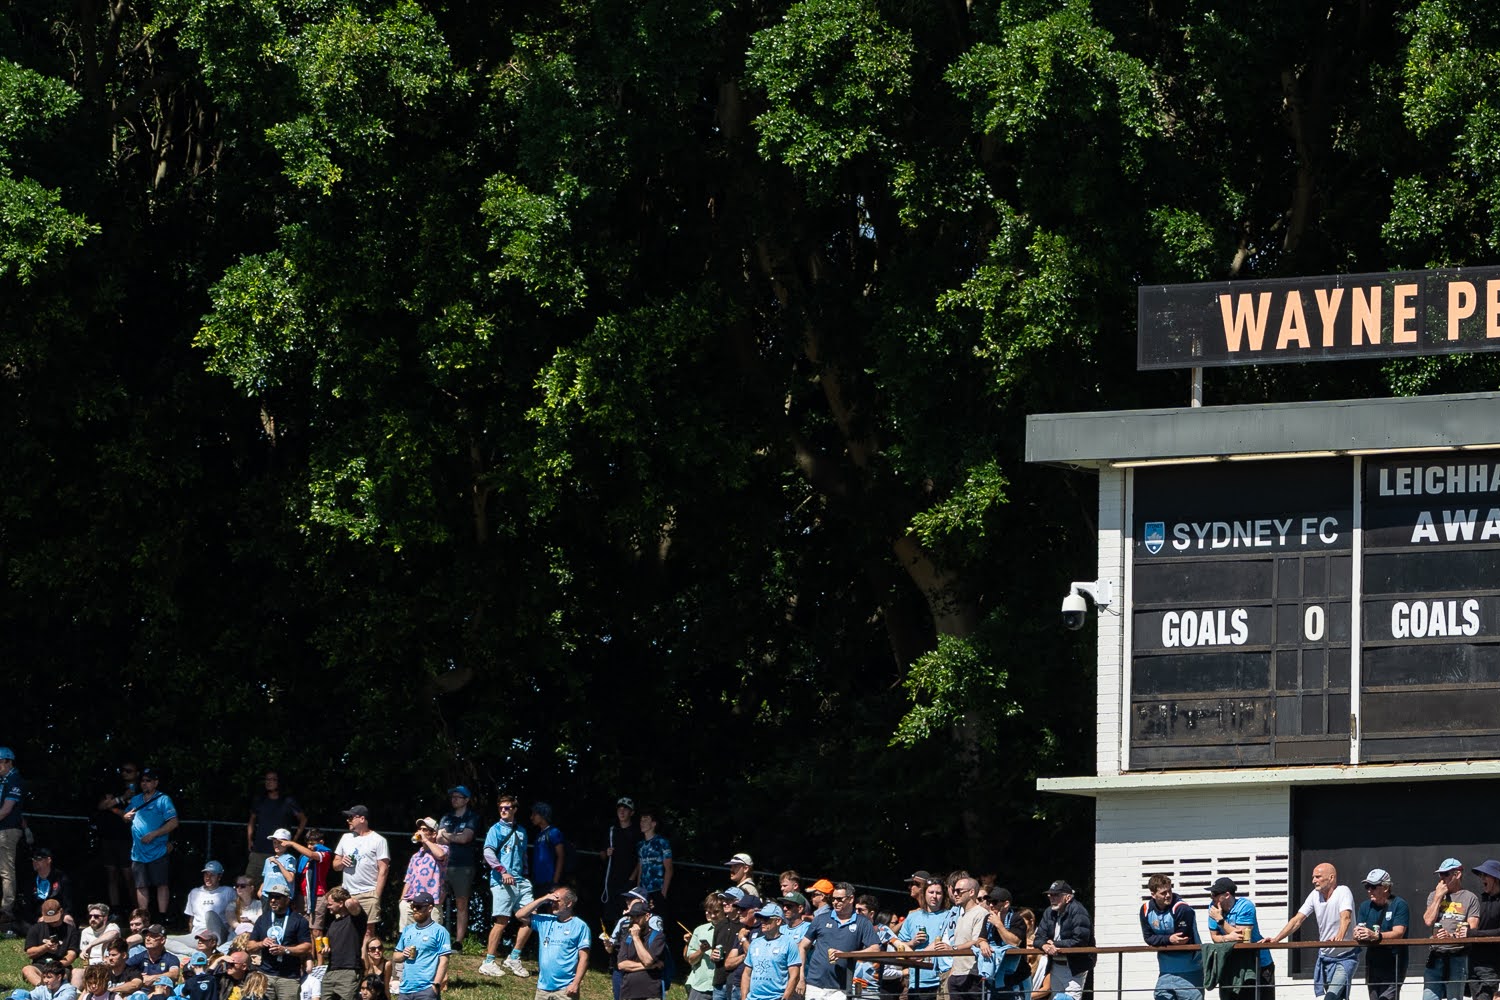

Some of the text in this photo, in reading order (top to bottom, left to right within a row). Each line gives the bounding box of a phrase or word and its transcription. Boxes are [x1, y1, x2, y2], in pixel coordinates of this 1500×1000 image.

[1219, 284, 1418, 352] WAYNE
[1172, 516, 1339, 550] SYDNEY FC
[1161, 605, 1325, 648] GOALS 0
[1391, 598, 1480, 639] GOALS
